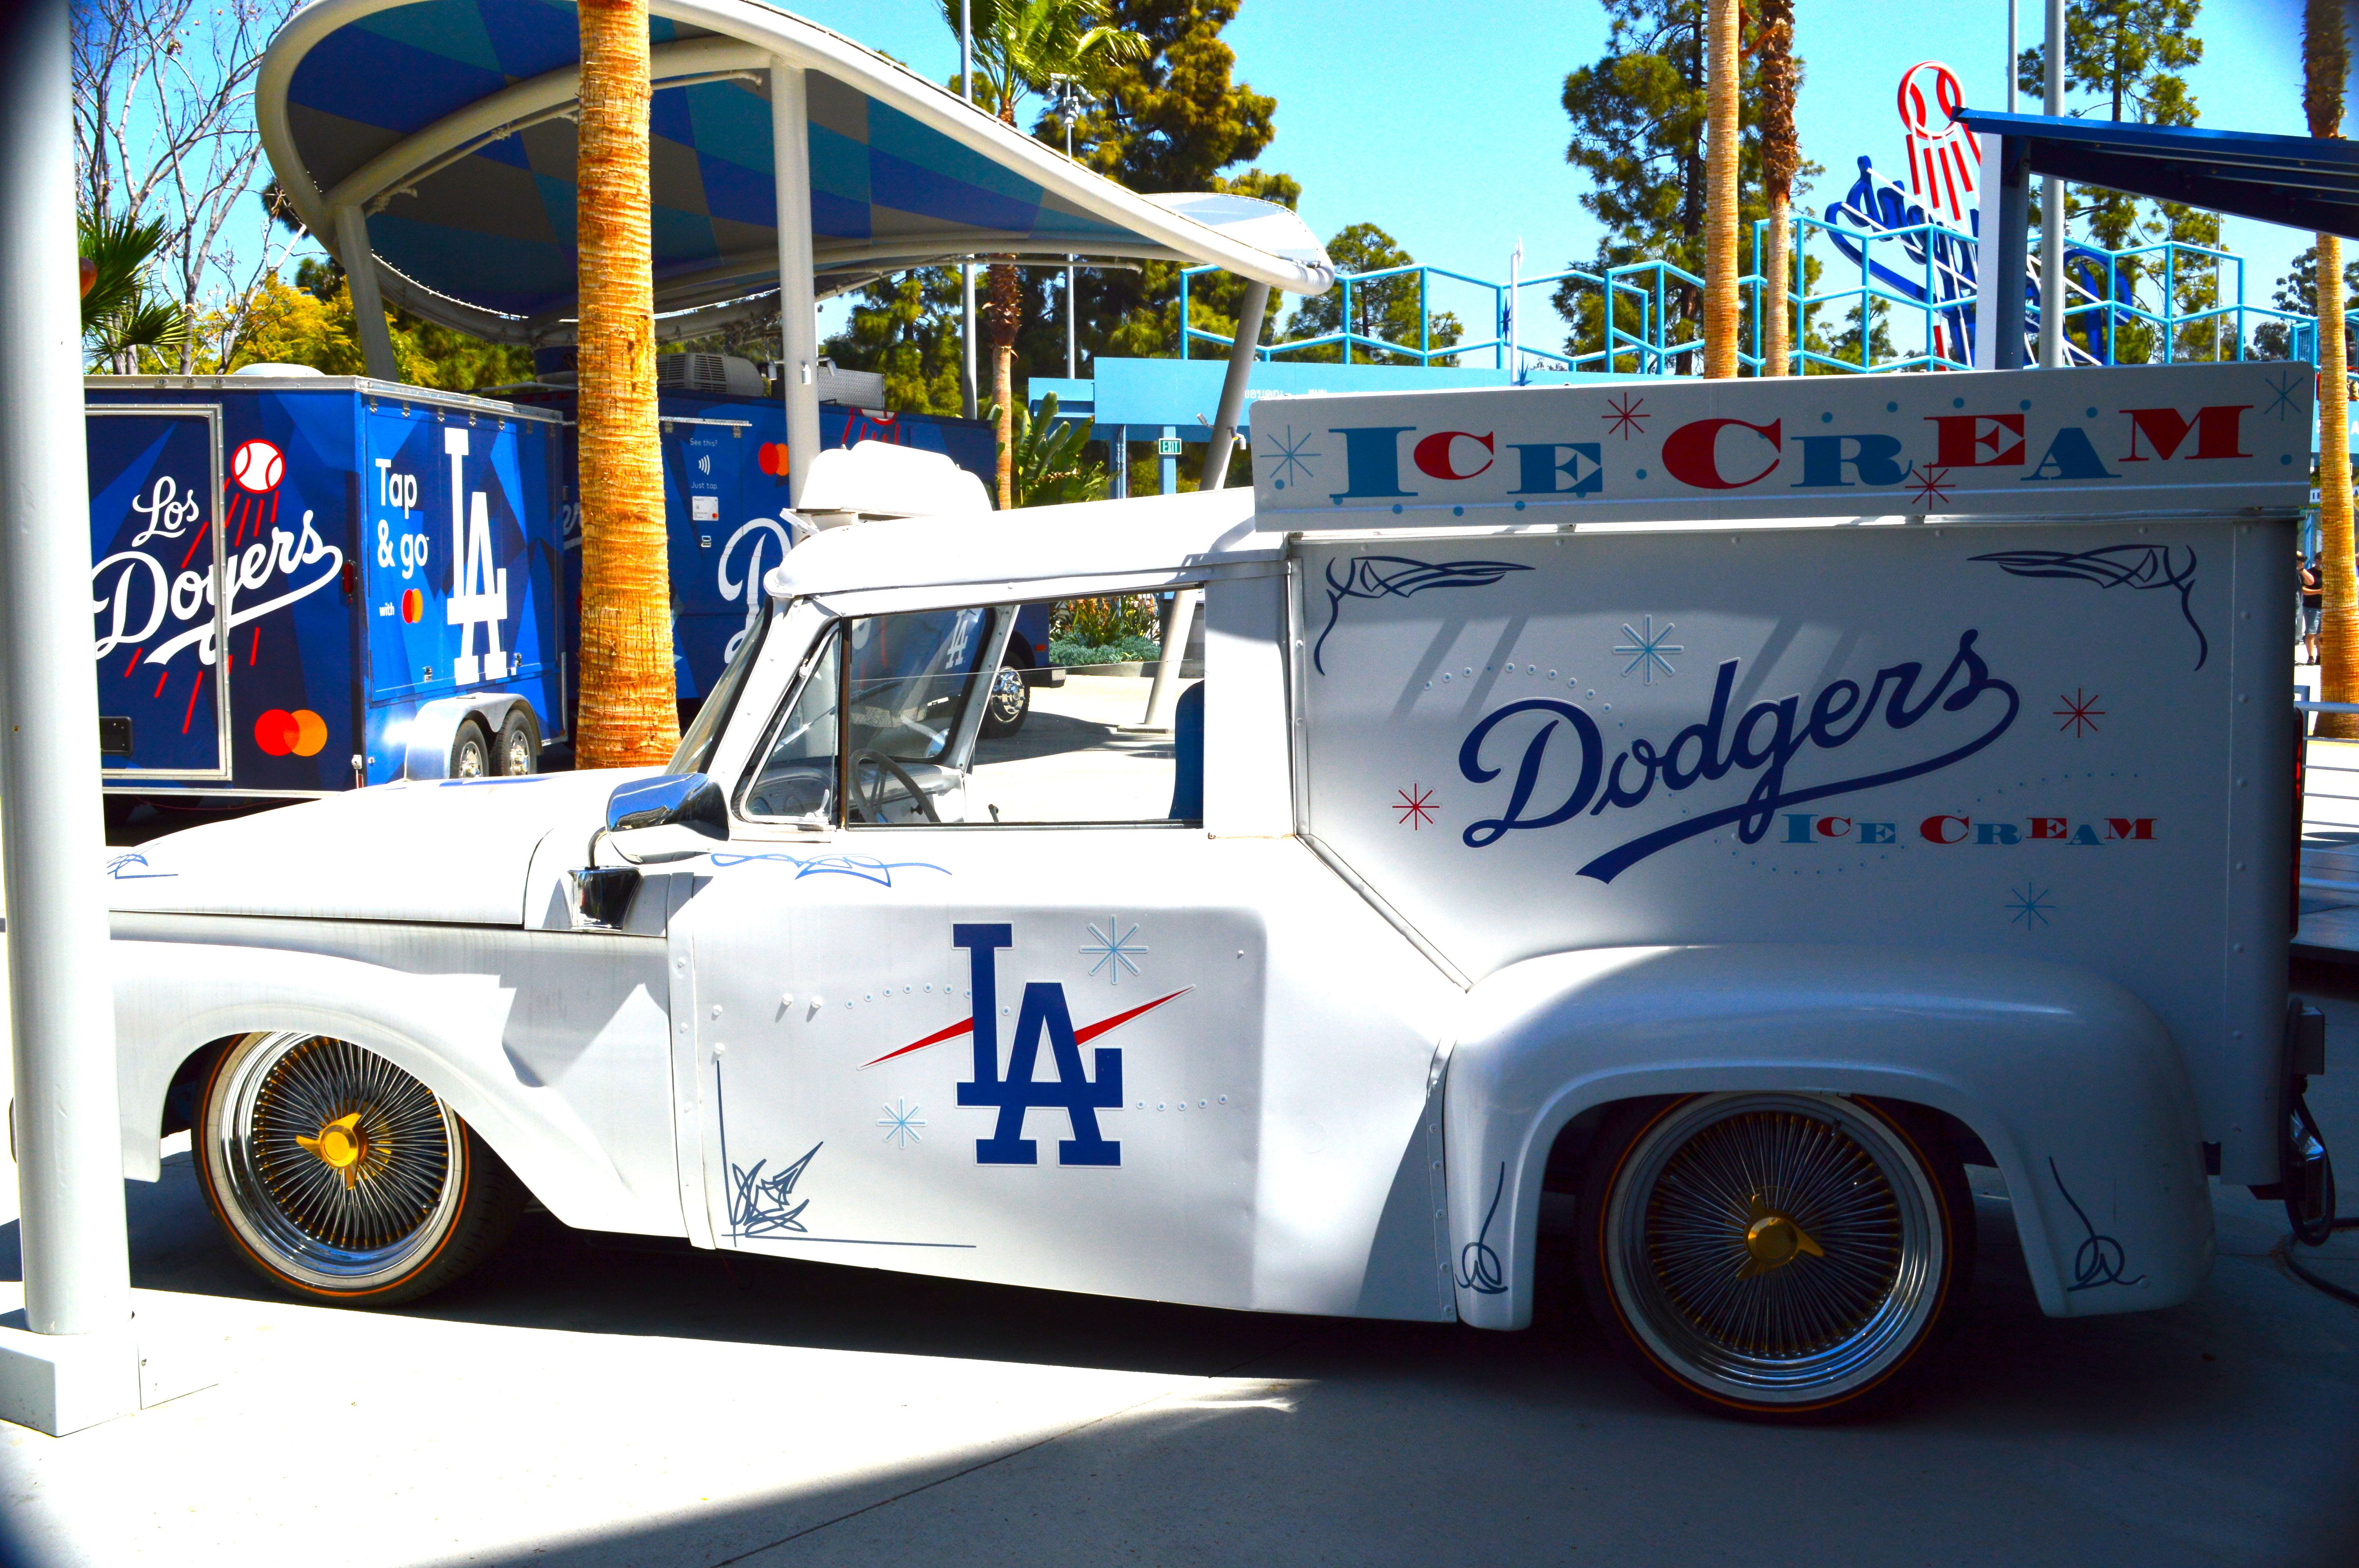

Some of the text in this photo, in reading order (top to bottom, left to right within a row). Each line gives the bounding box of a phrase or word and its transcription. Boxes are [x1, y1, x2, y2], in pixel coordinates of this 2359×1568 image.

[1163, 441, 1179, 453] EXIT
[1329, 407, 2254, 498] ICE CREAM
[132, 476, 199, 546] Los
[375, 458, 417, 519] Tap
[378, 519, 395, 568] &
[445, 428, 507, 686] LA
[92, 510, 343, 665] Doyers
[379, 603, 394, 617] with
[946, 609, 968, 669] LA
[1459, 628, 2020, 884] Dodgers
[1781, 814, 2157, 846] ICE CREAM
[953, 924, 1123, 1165] LA
